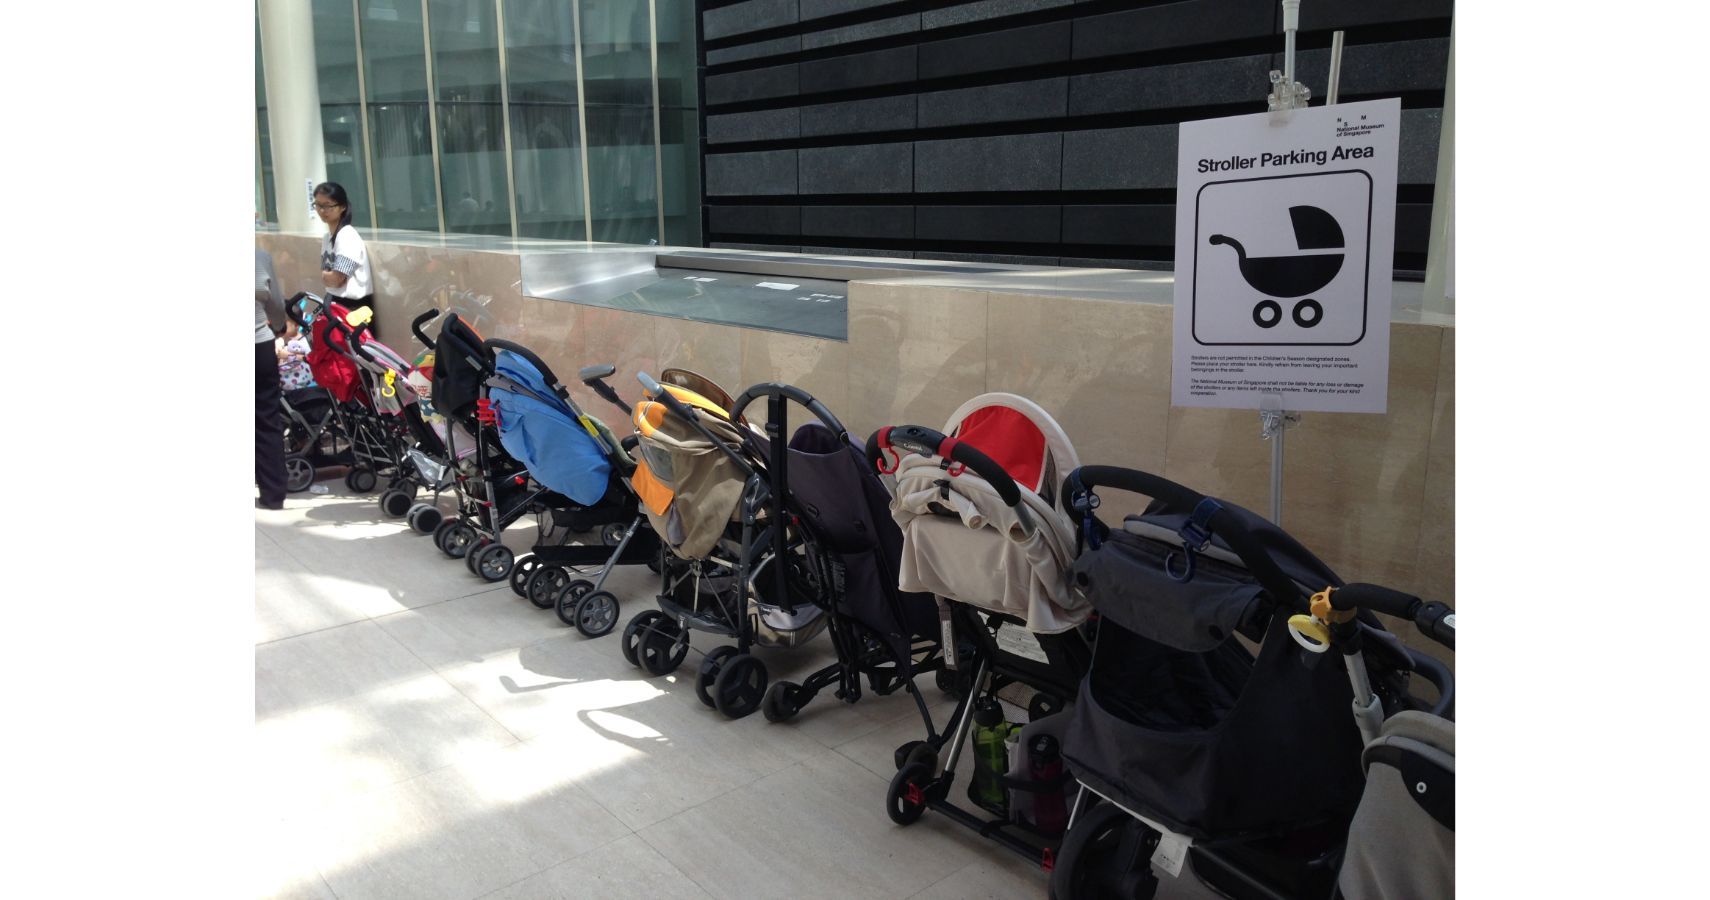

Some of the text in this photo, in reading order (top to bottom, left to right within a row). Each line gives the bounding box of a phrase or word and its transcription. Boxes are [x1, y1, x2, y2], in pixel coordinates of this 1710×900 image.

[1198, 146, 1374, 173] Stroller Parking Area
